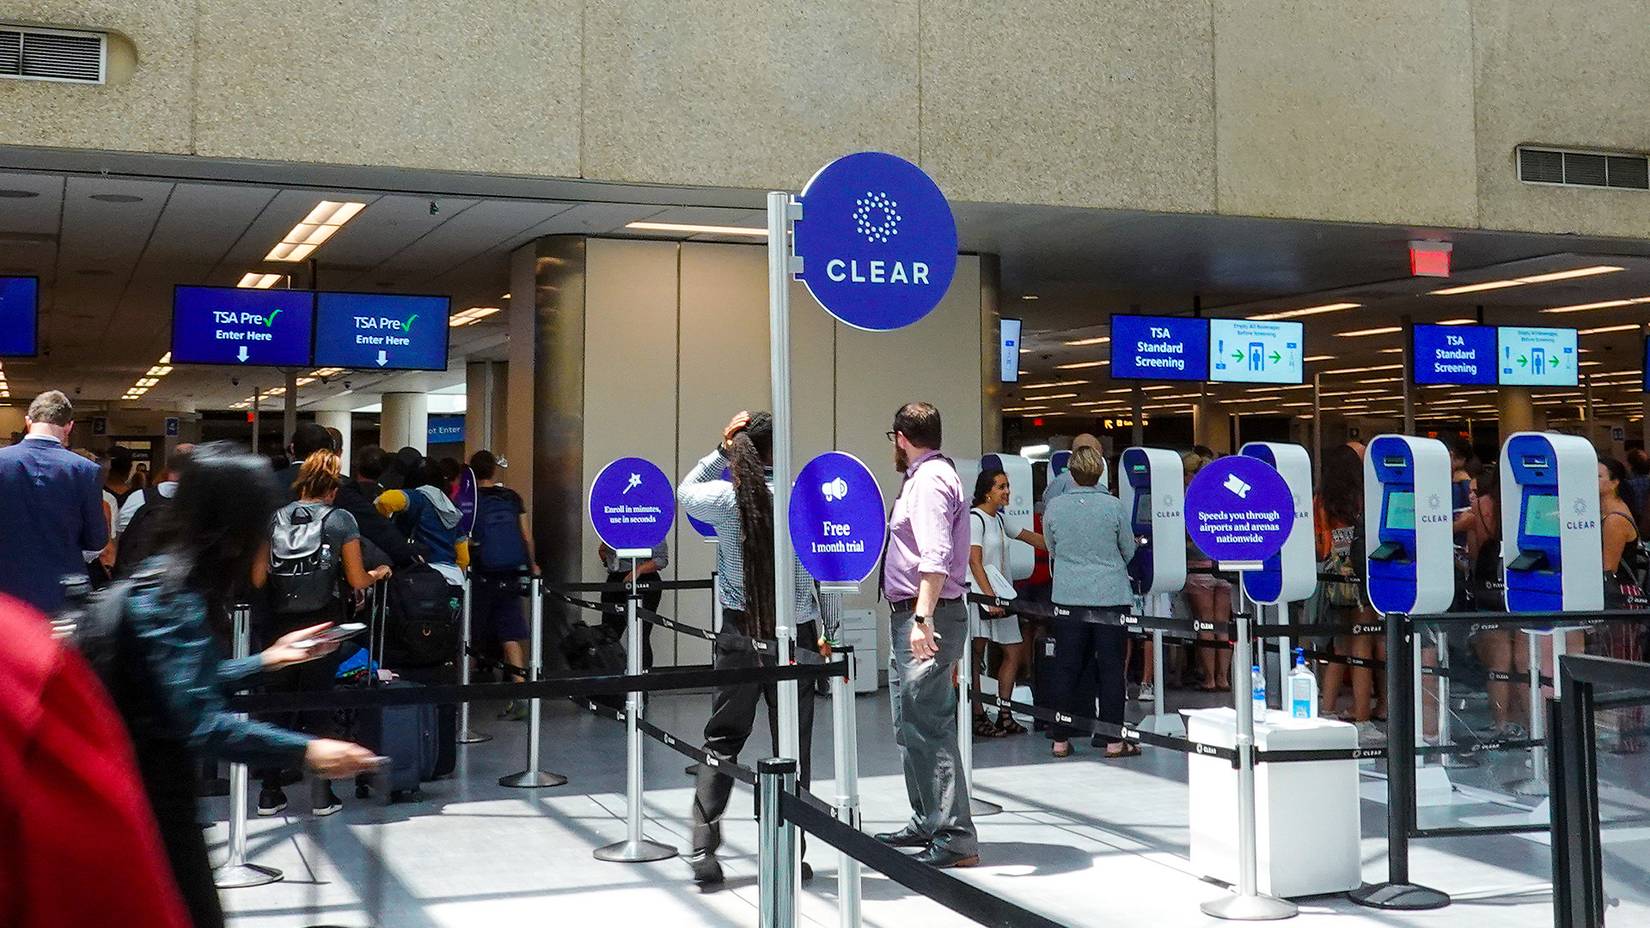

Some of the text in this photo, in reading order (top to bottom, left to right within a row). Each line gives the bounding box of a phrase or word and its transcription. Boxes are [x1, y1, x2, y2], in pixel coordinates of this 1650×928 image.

[826, 259, 929, 284] CLEAR
[213, 311, 263, 325] TSA Pre
[354, 316, 400, 330] TSA Pre
[215, 329, 272, 341] Enter Here
[1150, 327, 1171, 339] TSA
[356, 334, 410, 346] Enter Here
[1446, 335, 1465, 346] TSA
[1137, 341, 1183, 354] Standard
[1436, 349, 1476, 360] Standard
[1135, 356, 1185, 370] Screening
[1434, 362, 1477, 375] Screening
[604, 505, 662, 514] Enroll in minutes,
[1156, 511, 1181, 519] CLEAR
[1294, 511, 1309, 519] EAR
[610, 515, 656, 524] use in seconds
[1198, 510, 1280, 522] Speeds you through
[1421, 515, 1449, 523] CLEAR
[823, 521, 851, 536] Free
[1199, 522, 1280, 534] airports and arenas
[1566, 520, 1596, 530] CLEAR
[1216, 533, 1264, 543] nationwide
[811, 539, 865, 553] 1 month trial
